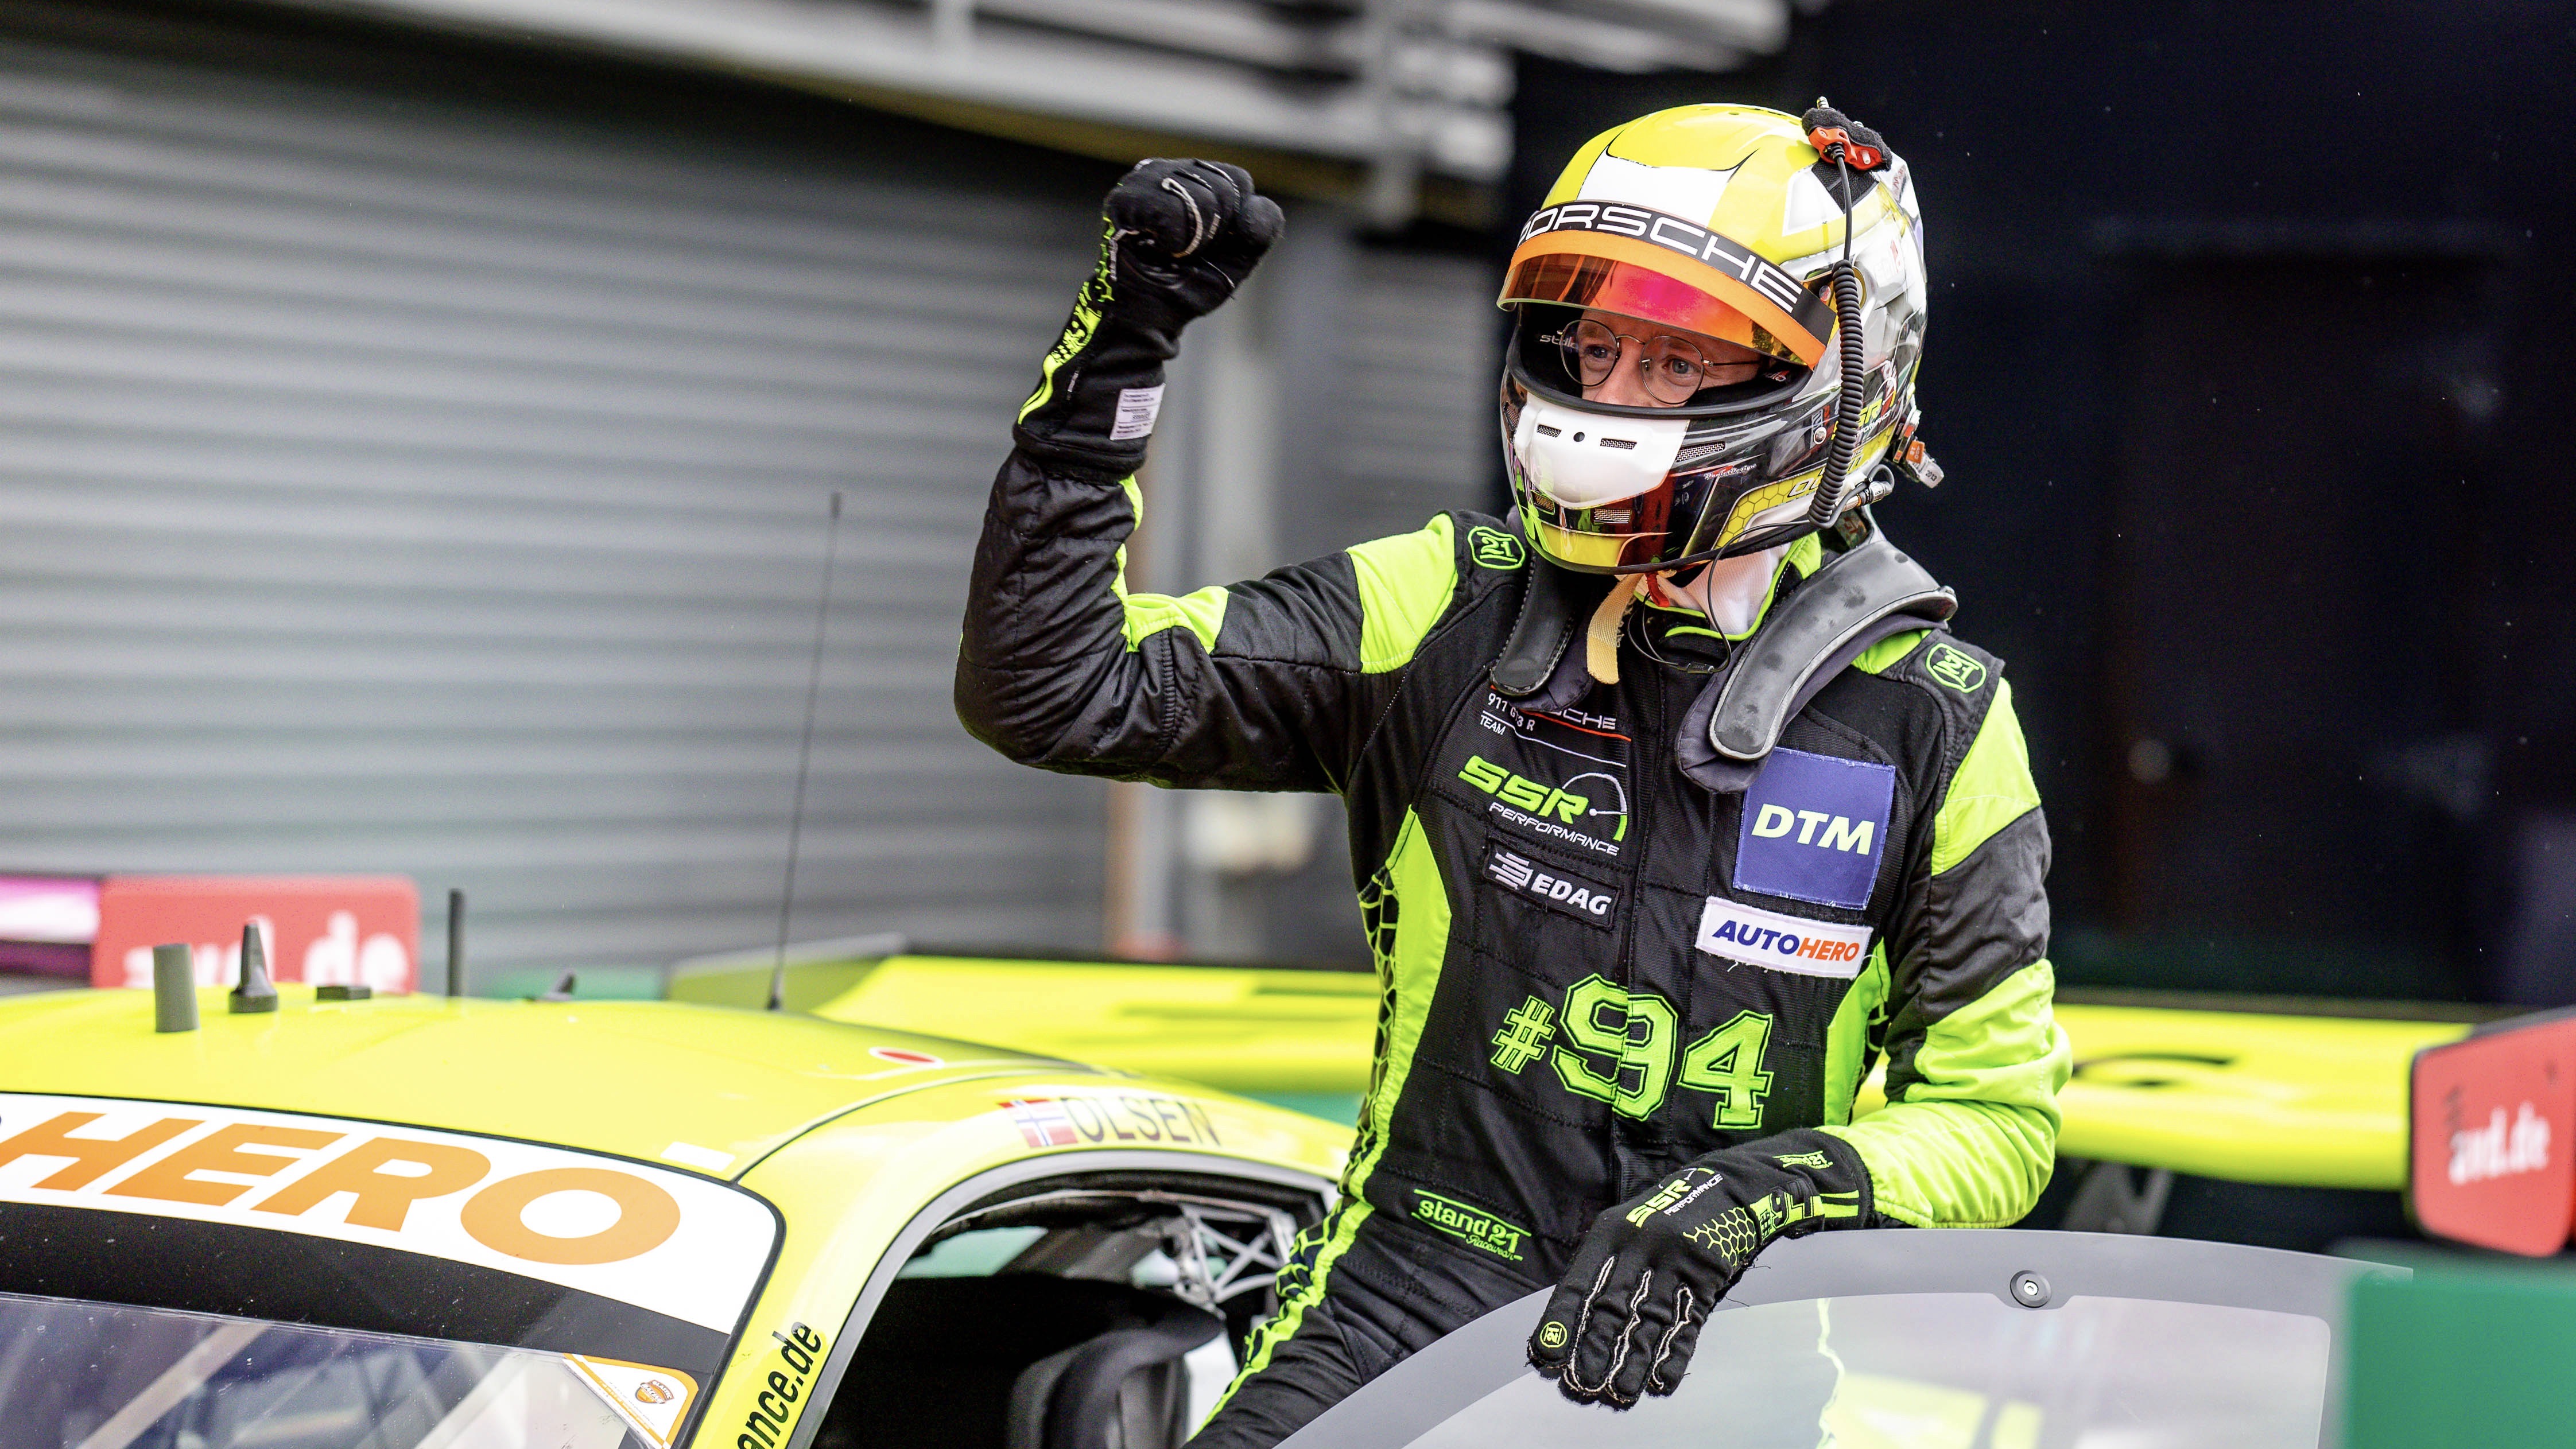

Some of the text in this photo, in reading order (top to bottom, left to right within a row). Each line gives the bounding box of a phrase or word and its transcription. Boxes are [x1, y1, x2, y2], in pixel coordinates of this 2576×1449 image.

[1517, 204, 1803, 314] PORSCHE
[1480, 714, 1507, 735] TEAM
[1488, 693, 1508, 713] 911
[1526, 719, 1536, 731] R
[1457, 755, 1589, 825] SSR
[1489, 802, 1620, 856] PERFORMANCE
[1751, 803, 1876, 856] DTM
[1531, 873, 1612, 915] EDAG
[1712, 919, 1860, 962] AUTOHERO
[1491, 973, 1774, 1129] #94
[1060, 1096, 1221, 1146] OLSEN
[0, 1111, 681, 1265] HERO
[1625, 1179, 1692, 1228] SSR
[1663, 1174, 1723, 1216] PERFORMANCE
